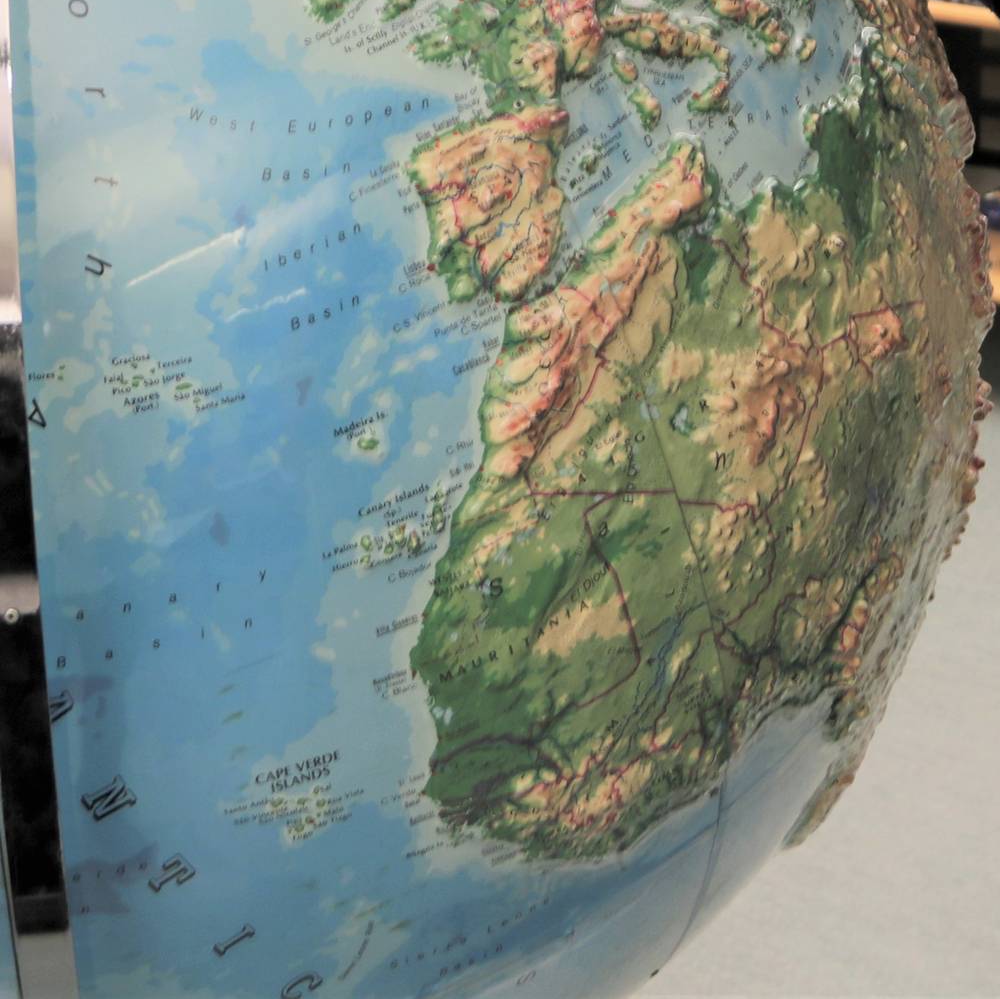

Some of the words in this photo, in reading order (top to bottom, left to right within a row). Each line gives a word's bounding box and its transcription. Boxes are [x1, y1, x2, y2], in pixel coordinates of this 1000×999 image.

[188, 106, 256, 132] West
[287, 97, 430, 135] European
[261, 160, 351, 183] Basin
[263, 221, 362, 272] Iberian
[290, 293, 360, 332] Basin
[111, 353, 151, 367] Graciosa
[157, 355, 193, 369] Terceira
[28, 372, 56, 382] Flores
[112, 386, 132, 397] Pico
[123, 391, 161, 408] Azores
[192, 382, 224, 400] Miguel
[333, 414, 375, 438] Madeira
[357, 499, 392, 518] Canary
[395, 482, 431, 503] Islands
[254, 764, 290, 785] CAPE
[295, 749, 340, 772] VERDE
[271, 766, 331, 793] ISLANDS
